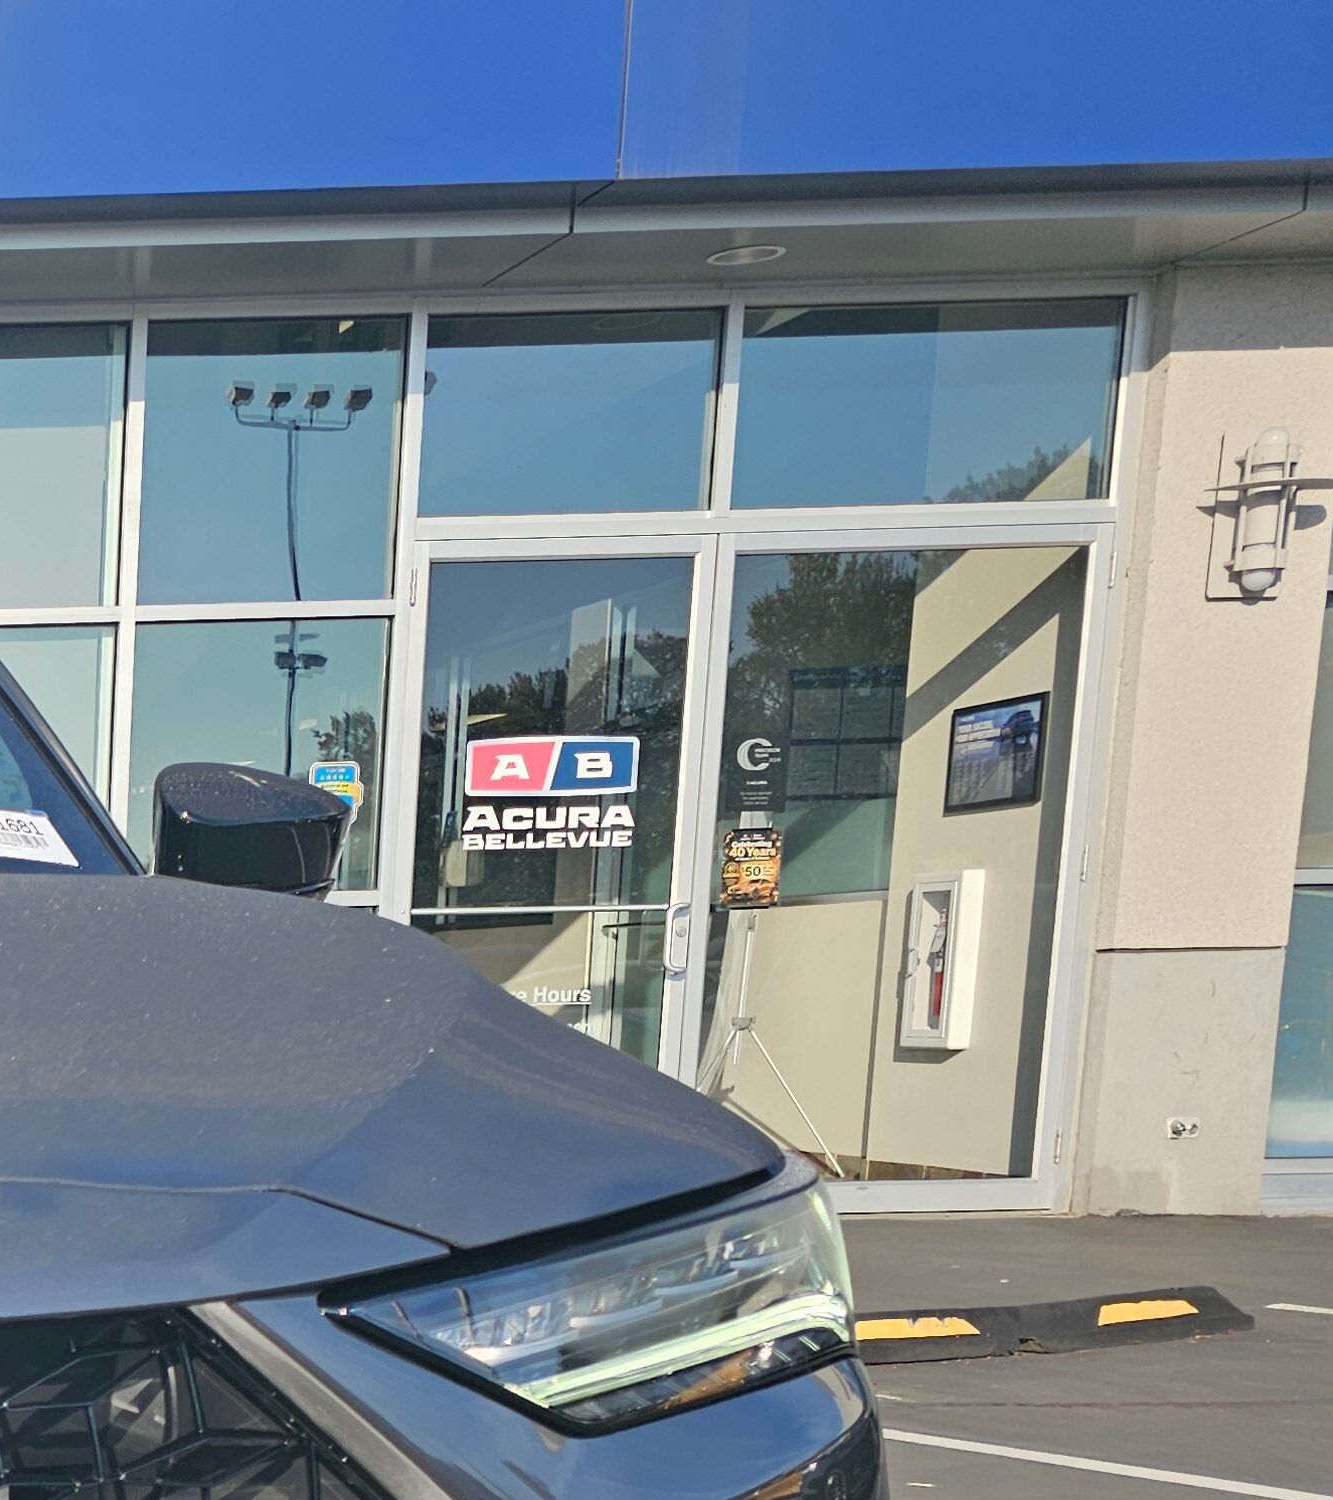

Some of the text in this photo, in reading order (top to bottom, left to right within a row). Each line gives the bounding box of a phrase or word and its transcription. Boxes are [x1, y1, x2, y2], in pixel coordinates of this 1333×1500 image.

[490, 752, 613, 780] A B
[462, 805, 635, 831] ACURA
[461, 830, 633, 850] BELLEVUE
[728, 847, 777, 858] 40 Years
[533, 986, 591, 1003] Hours
